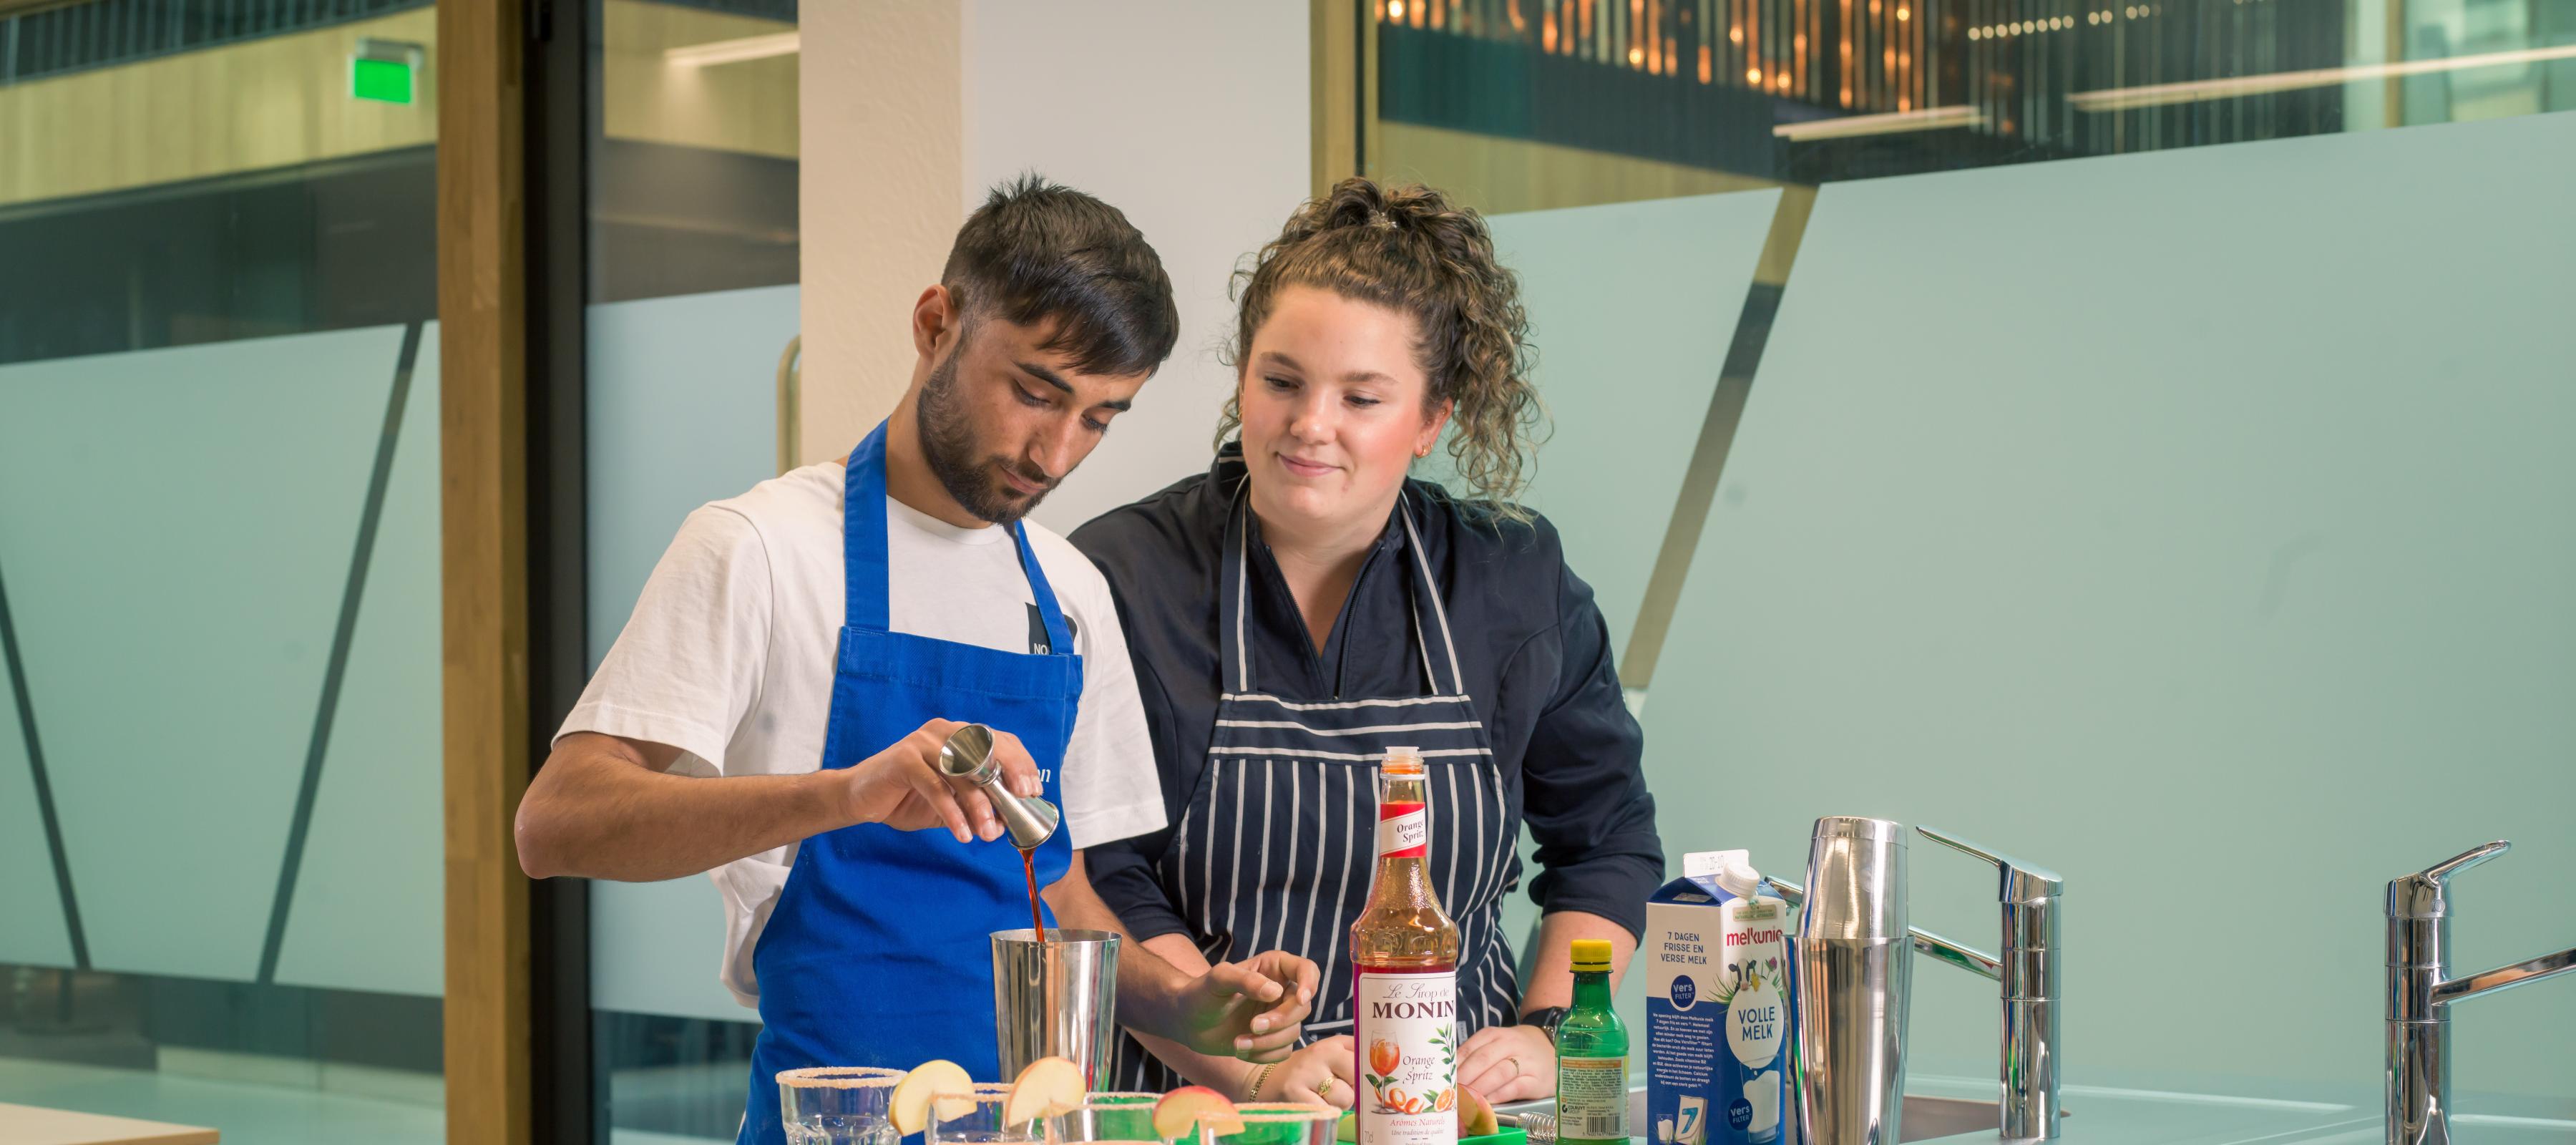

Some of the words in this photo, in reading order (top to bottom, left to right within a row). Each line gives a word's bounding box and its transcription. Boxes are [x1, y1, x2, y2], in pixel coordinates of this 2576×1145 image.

[1034, 643, 1049, 654] NO
[1397, 819, 1424, 833] Orange
[1674, 932, 1699, 942] DAGEN
[1727, 925, 1783, 946] melkunie
[1664, 942, 1690, 952] FRISSE
[1693, 945, 1704, 953] EN
[1661, 953, 1685, 963] VERSE
[1688, 955, 1707, 965] MELK
[1382, 983, 1402, 998] Le
[1405, 983, 1438, 1001] Sirop
[1372, 1000, 1454, 1018] MONIN
[1738, 1006, 1775, 1024] VOLLE
[1742, 1023, 1772, 1041] MELK
[1402, 1056, 1435, 1068] Orange
[1402, 1067, 1433, 1084] Spritz
